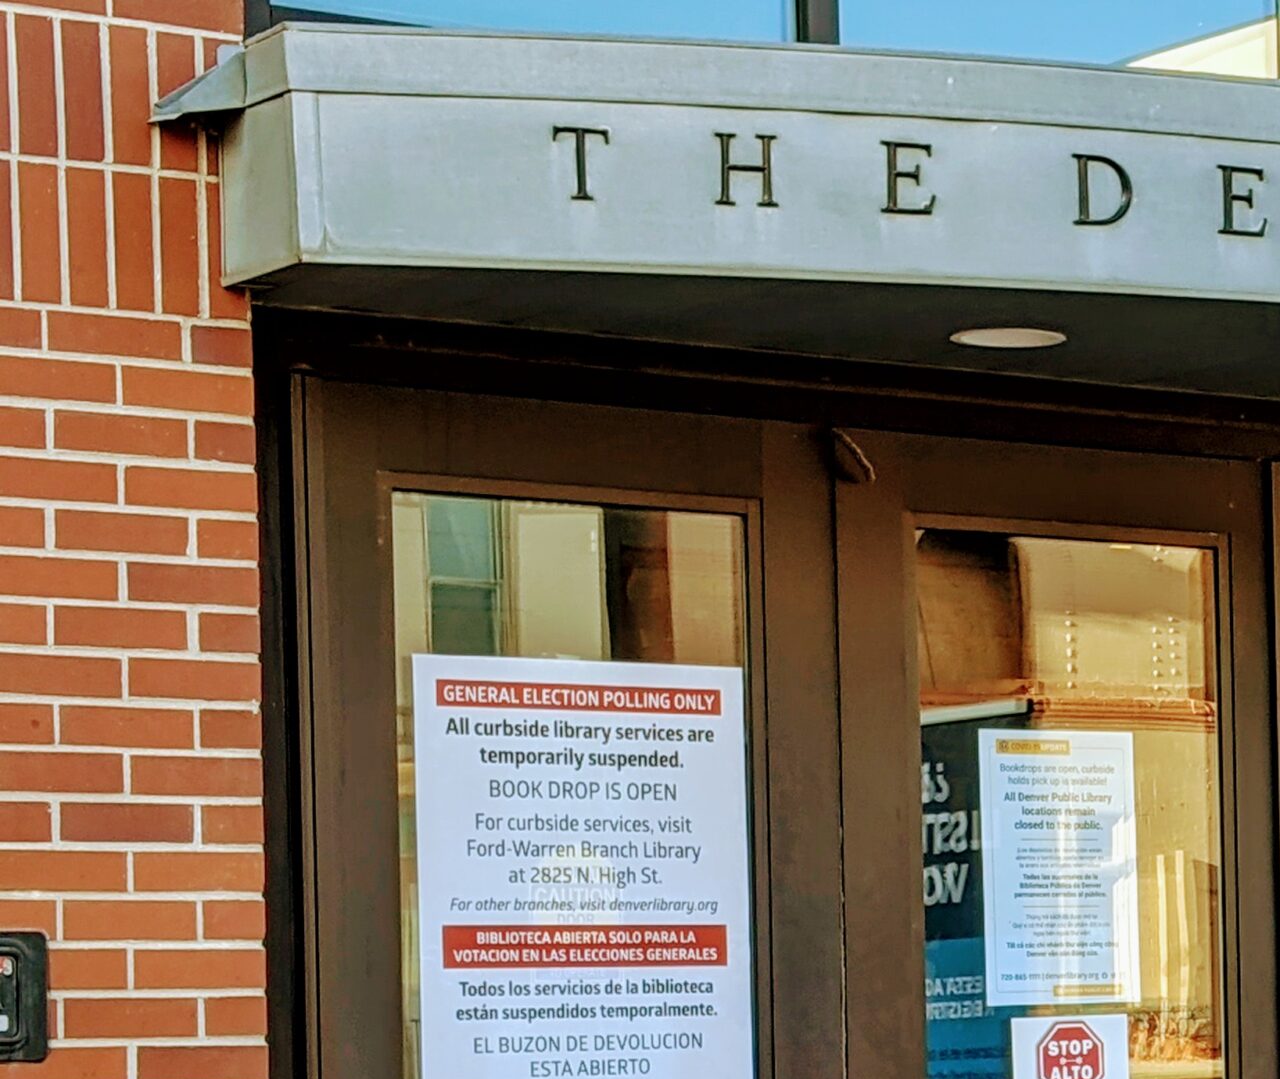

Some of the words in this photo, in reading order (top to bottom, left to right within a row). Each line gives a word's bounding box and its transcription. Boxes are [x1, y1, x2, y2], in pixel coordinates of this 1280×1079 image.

[552, 126, 936, 216] THE
[443, 685, 519, 704] GENERAL
[523, 688, 599, 706] ELECTION
[603, 691, 670, 709] POLLING
[674, 693, 715, 710] ONLY
[445, 717, 469, 735] All
[473, 719, 549, 737] curbside
[553, 720, 611, 744] library
[615, 723, 684, 741] services
[687, 729, 714, 742] are
[479, 747, 585, 770] temporarily
[588, 750, 684, 770] suspended.
[489, 779, 543, 798] BOOK
[548, 780, 600, 799] DROP
[605, 782, 621, 800] IS
[626, 782, 676, 801] OPEN
[1004, 792, 1016, 801] All
[1018, 793, 1049, 802] Denver
[1051, 793, 1079, 802] Public
[1081, 793, 1112, 805] Library
[475, 812, 503, 831] For
[507, 813, 579, 831] curbside
[583, 815, 654, 834] services,
[657, 816, 692, 833] visit
[1014, 820, 1044, 830] closed
[1046, 821, 1055, 830] to
[466, 839, 577, 859] Ford-Warren
[579, 840, 638, 860] Branch
[643, 841, 701, 864] Library
[458, 981, 505, 997] Todos
[508, 980, 531, 996] los
[534, 979, 601, 996] servicios
[604, 979, 622, 995] de
[625, 979, 638, 994] la
[642, 978, 713, 994] biblioteca
[455, 1004, 498, 1021] están
[502, 1003, 597, 1022] suspendidos
[599, 1002, 717, 1022] temporalmente.
[473, 1036, 494, 1054] EL
[498, 1036, 560, 1053] BUZON
[566, 1035, 588, 1052] DE
[594, 1032, 702, 1051] DEVOLUCION
[1047, 1039, 1094, 1057] STOP
